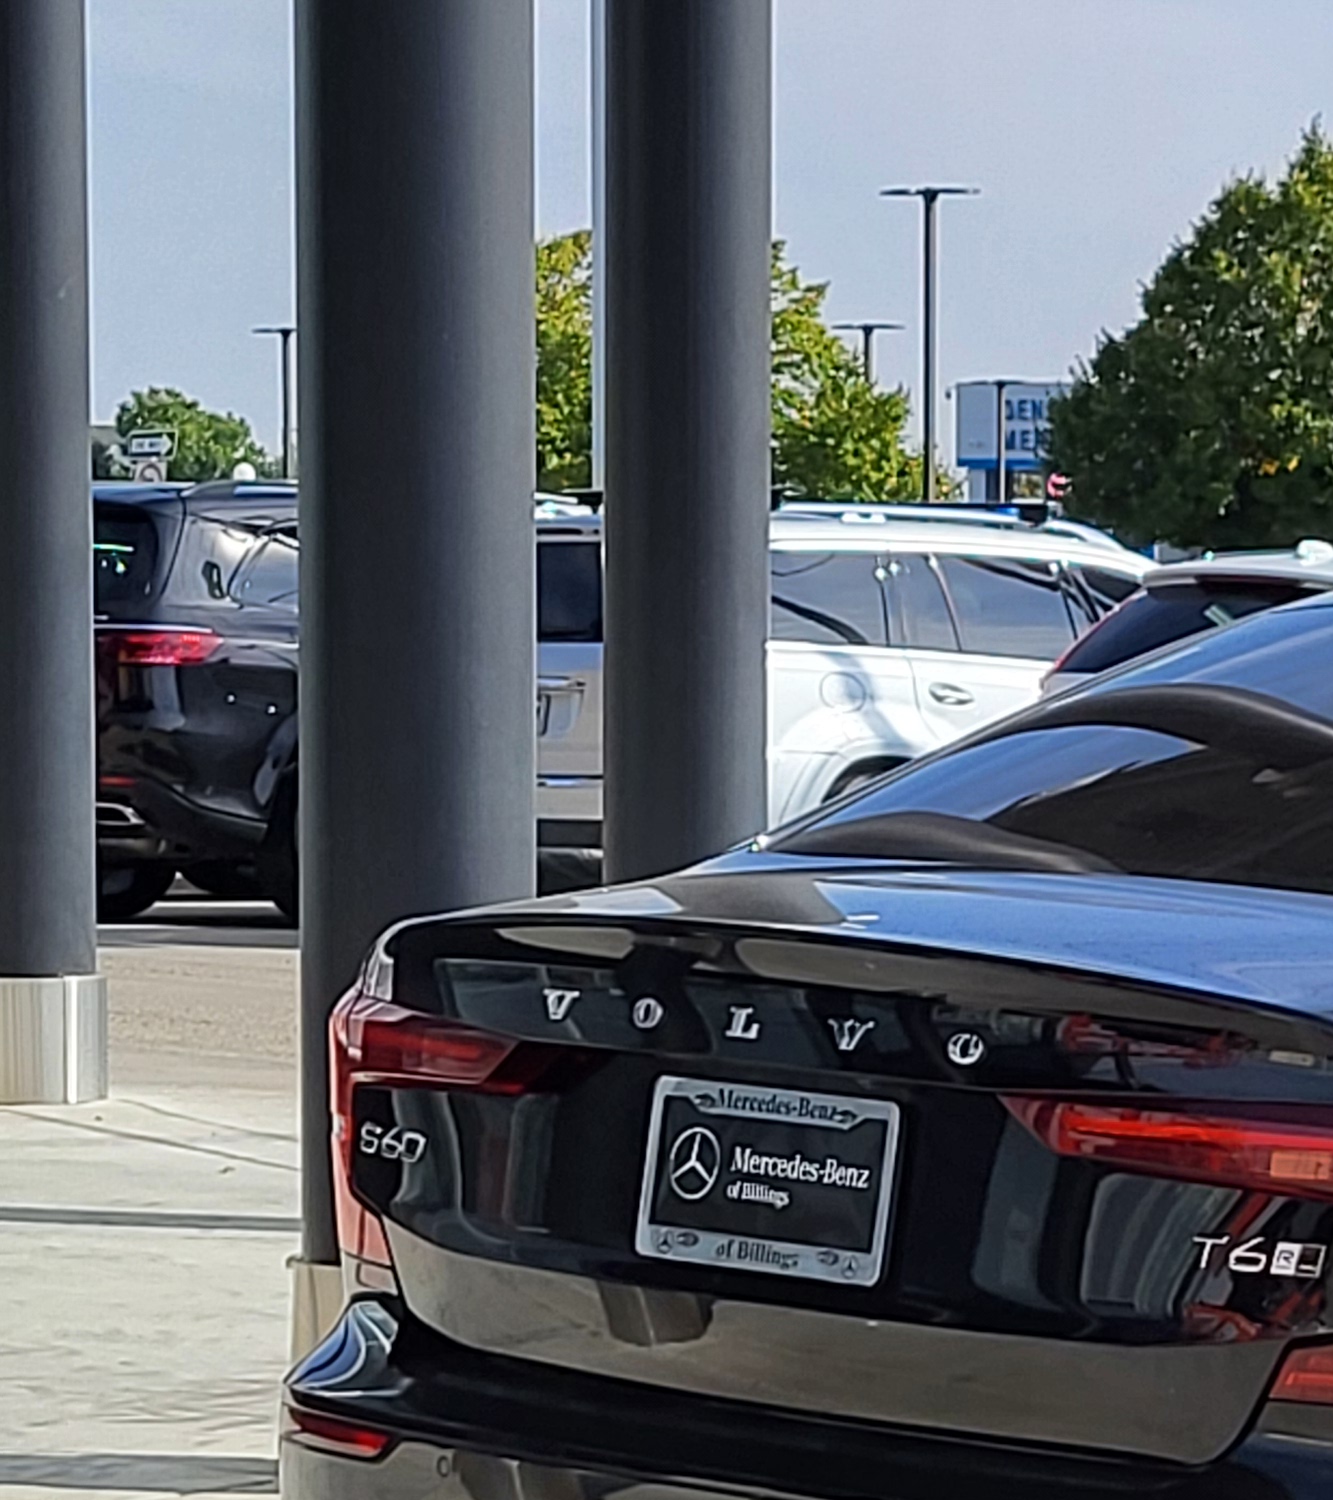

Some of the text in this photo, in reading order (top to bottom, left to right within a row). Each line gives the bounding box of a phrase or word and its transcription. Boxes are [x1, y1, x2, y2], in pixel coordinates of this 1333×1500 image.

[542, 987, 985, 1065] VOLVO
[716, 1088, 838, 1121] Mercedes-Benz
[360, 1120, 427, 1163] S60
[729, 1146, 870, 1189] Mercedes-Benz
[726, 1180, 790, 1210] of Billings
[715, 1238, 800, 1270] of Billings
